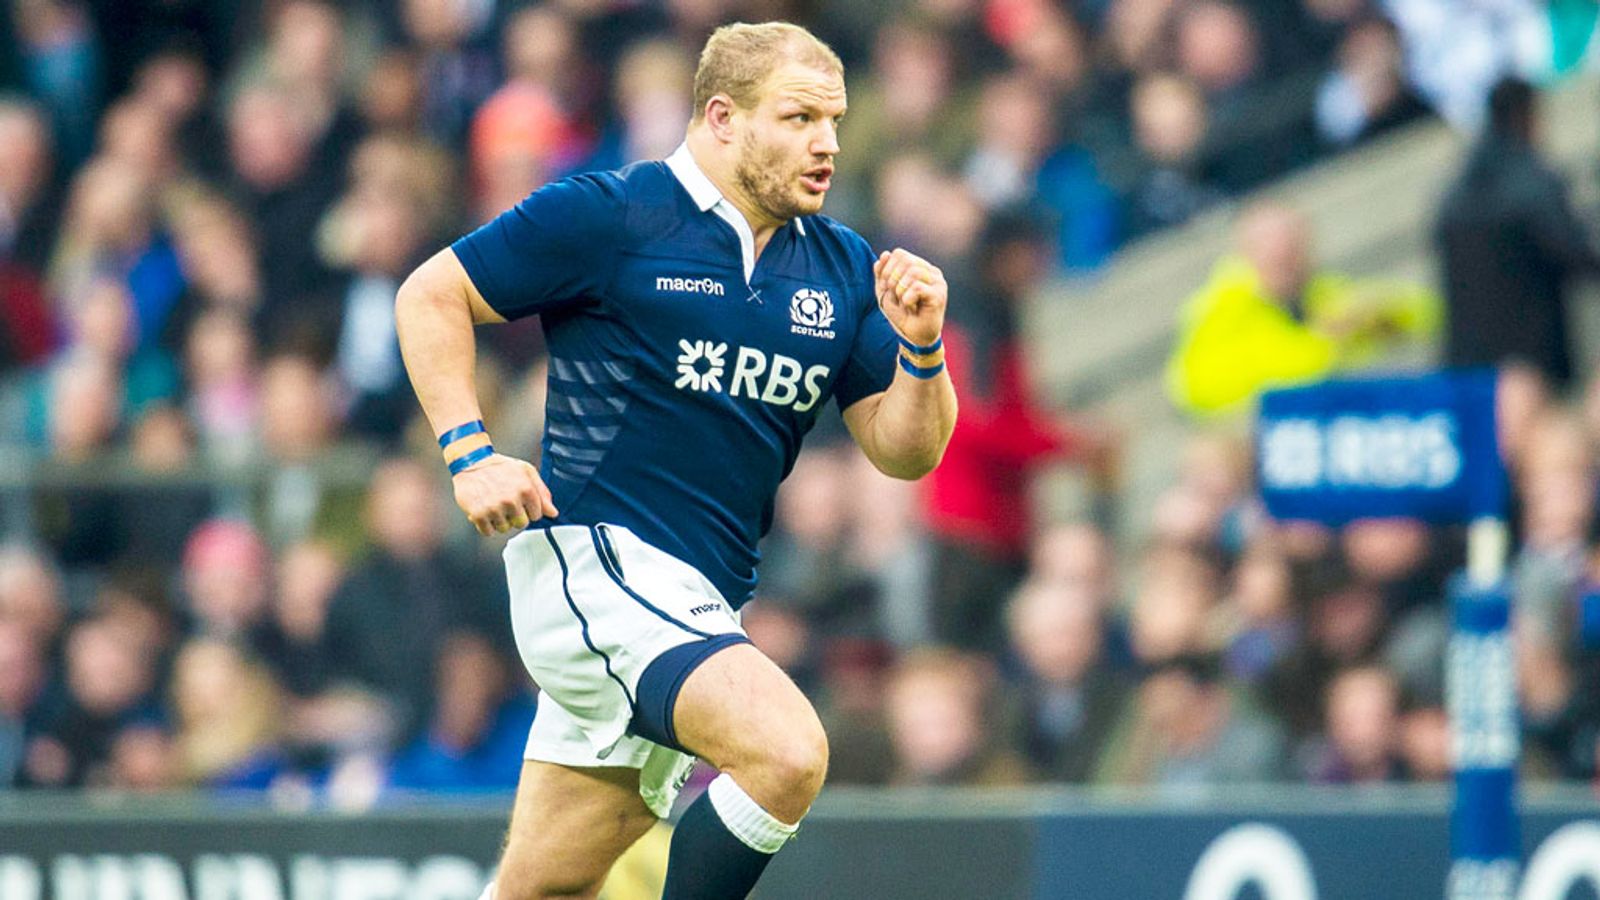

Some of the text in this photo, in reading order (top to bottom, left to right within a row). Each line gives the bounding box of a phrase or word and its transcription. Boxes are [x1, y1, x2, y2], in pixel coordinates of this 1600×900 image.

[656, 277, 725, 296] macron
[791, 325, 836, 340] SCOTLAND
[729, 346, 830, 412] RBS
